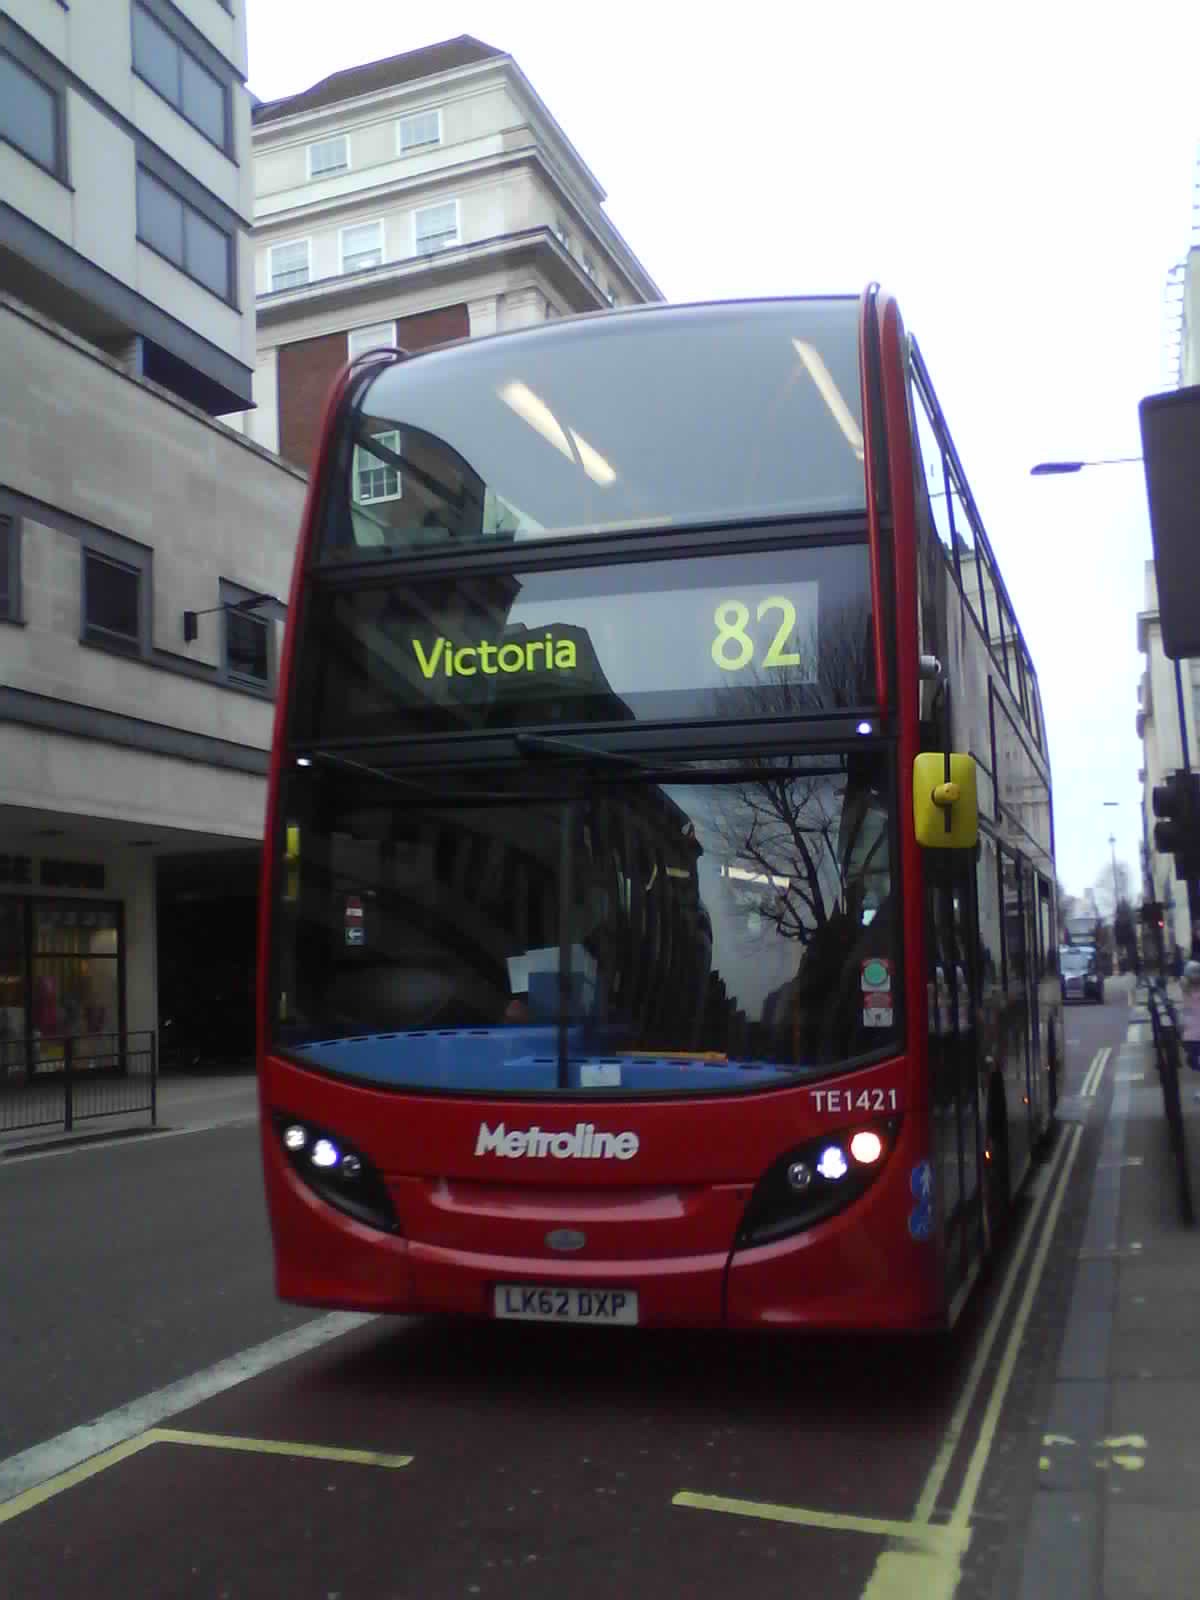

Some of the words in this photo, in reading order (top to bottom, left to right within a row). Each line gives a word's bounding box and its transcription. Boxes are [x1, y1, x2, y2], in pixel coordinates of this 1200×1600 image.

[710, 595, 801, 671] 82
[412, 633, 577, 678] Victoria
[811, 1088, 898, 1113] TE1421
[474, 1121, 640, 1160] Metroline
[504, 1289, 570, 1315] LK62
[577, 1293, 627, 1318] DXP
